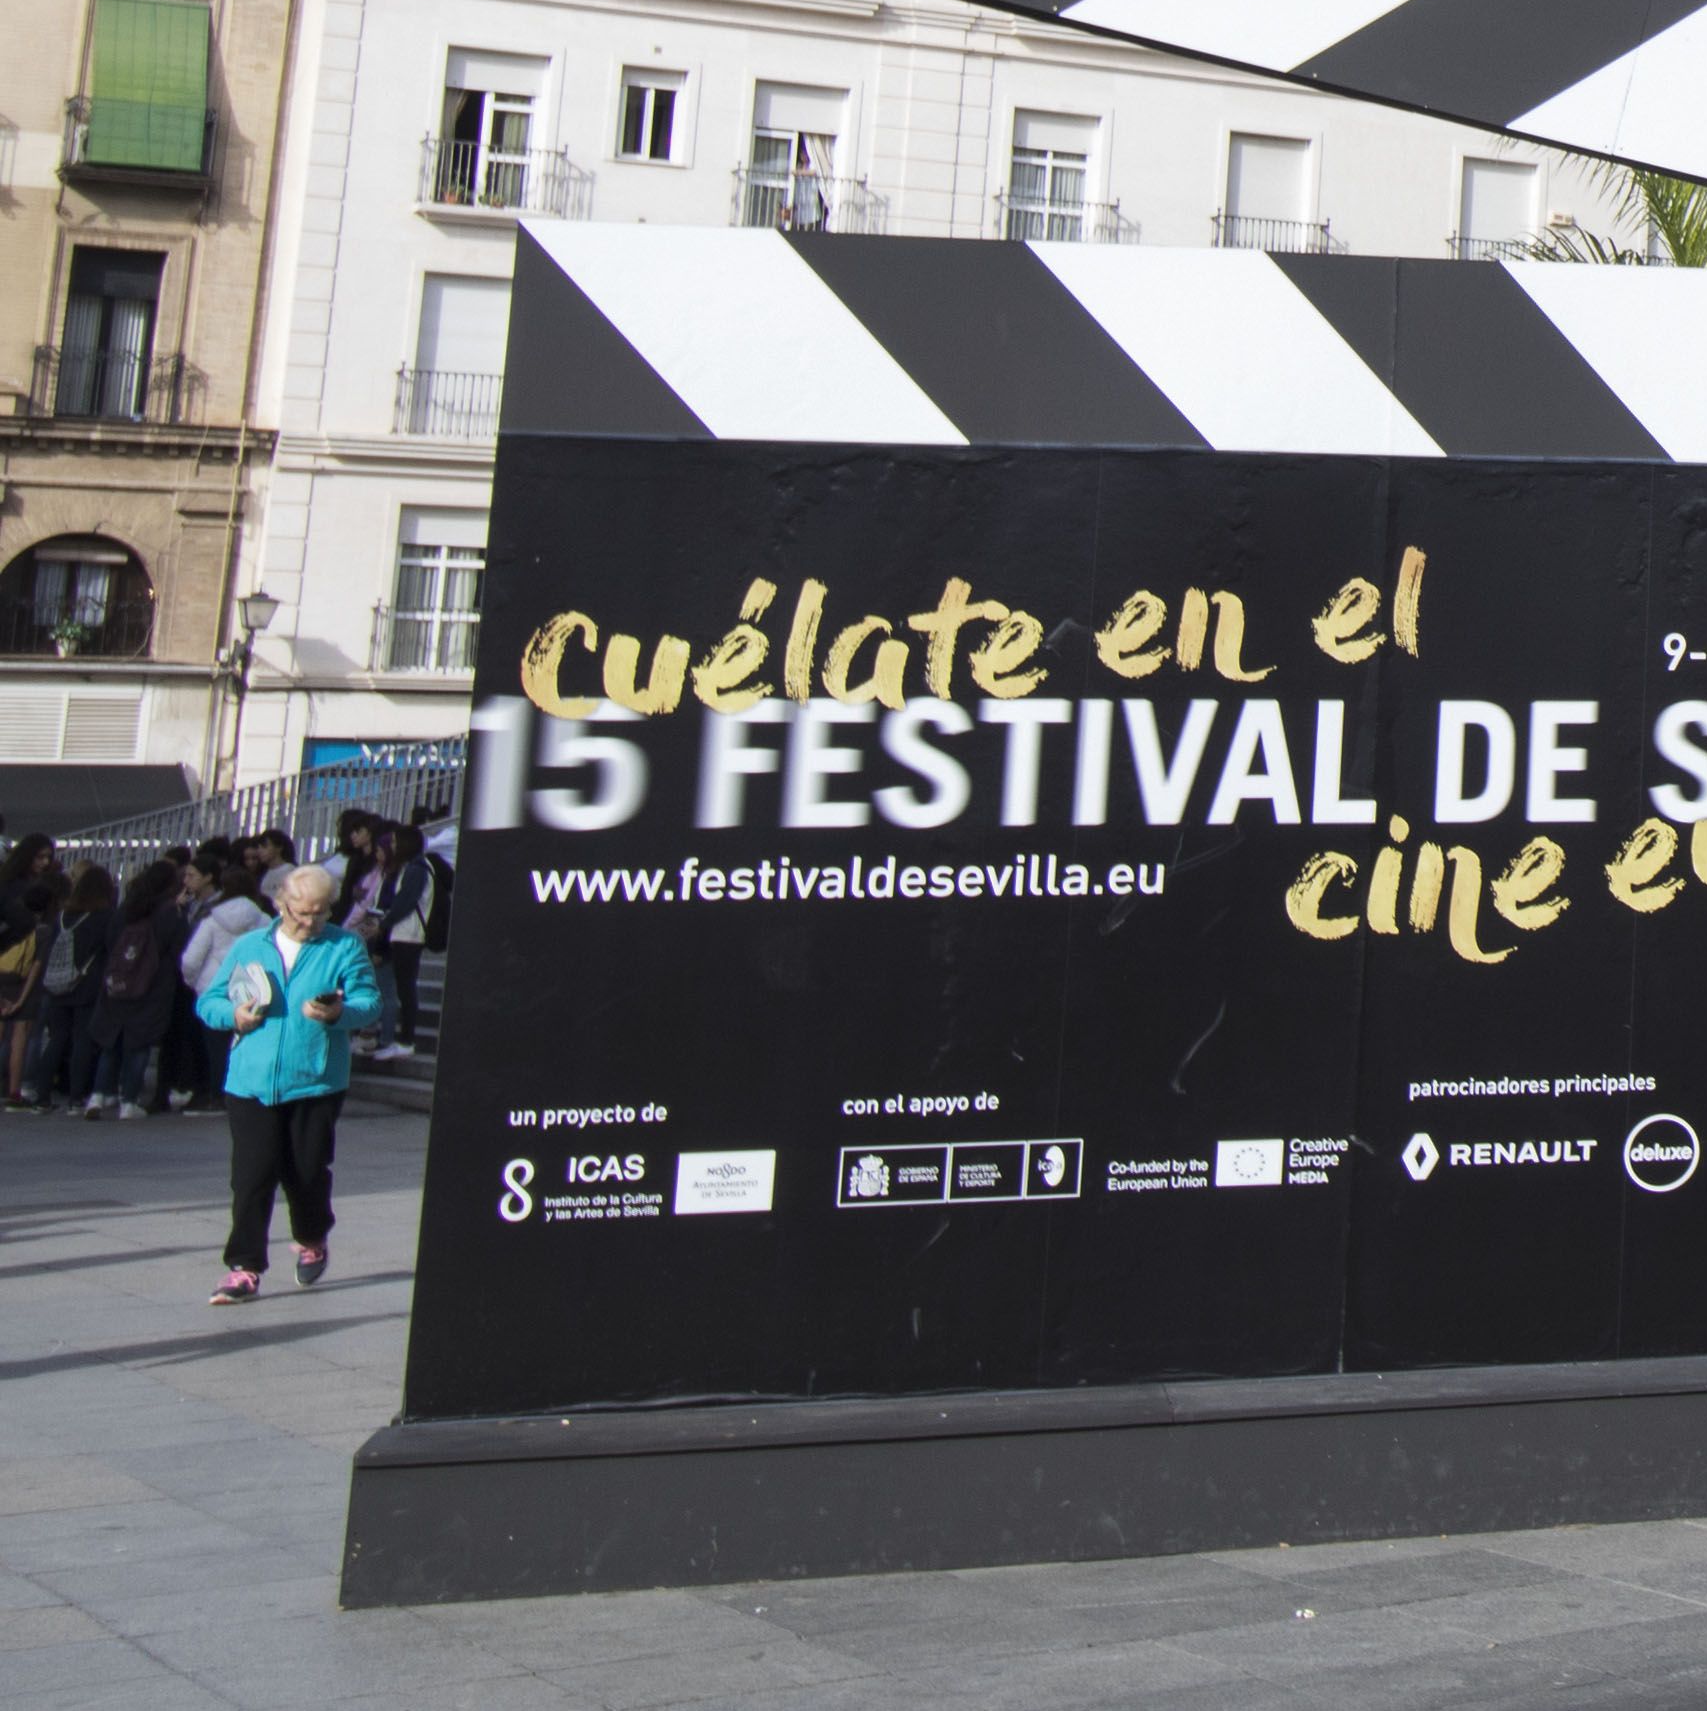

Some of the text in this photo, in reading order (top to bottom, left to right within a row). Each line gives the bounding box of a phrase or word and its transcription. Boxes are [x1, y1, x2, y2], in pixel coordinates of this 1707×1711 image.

[520, 546, 1427, 719] cuélate en el
[469, 694, 650, 831] 15
[694, 697, 1377, 829] FESTIVAL
[1434, 699, 1598, 824] DE
[532, 854, 1165, 904] www.festivaldesevilla.eu
[1286, 815, 1571, 965] cine
[1409, 1072, 1656, 1101] patrocinadores principales
[509, 1102, 668, 1130] un proyecto de
[843, 1091, 1000, 1117] con el apoyo de
[1289, 1137, 1349, 1153] Creative
[1450, 1139, 1598, 1166] RENAULT
[1629, 1143, 1693, 1162] deluxe
[568, 1154, 645, 1183] ICAS
[1108, 1158, 1209, 1175] Co-funded by the
[1289, 1153, 1340, 1168] Europe
[1108, 1174, 1208, 1192] European Union
[1288, 1170, 1329, 1185] MEDIA
[544, 1195, 590, 1207] Instituto
[622, 1192, 663, 1205] Cultura
[623, 1204, 660, 1218] Sevilla
